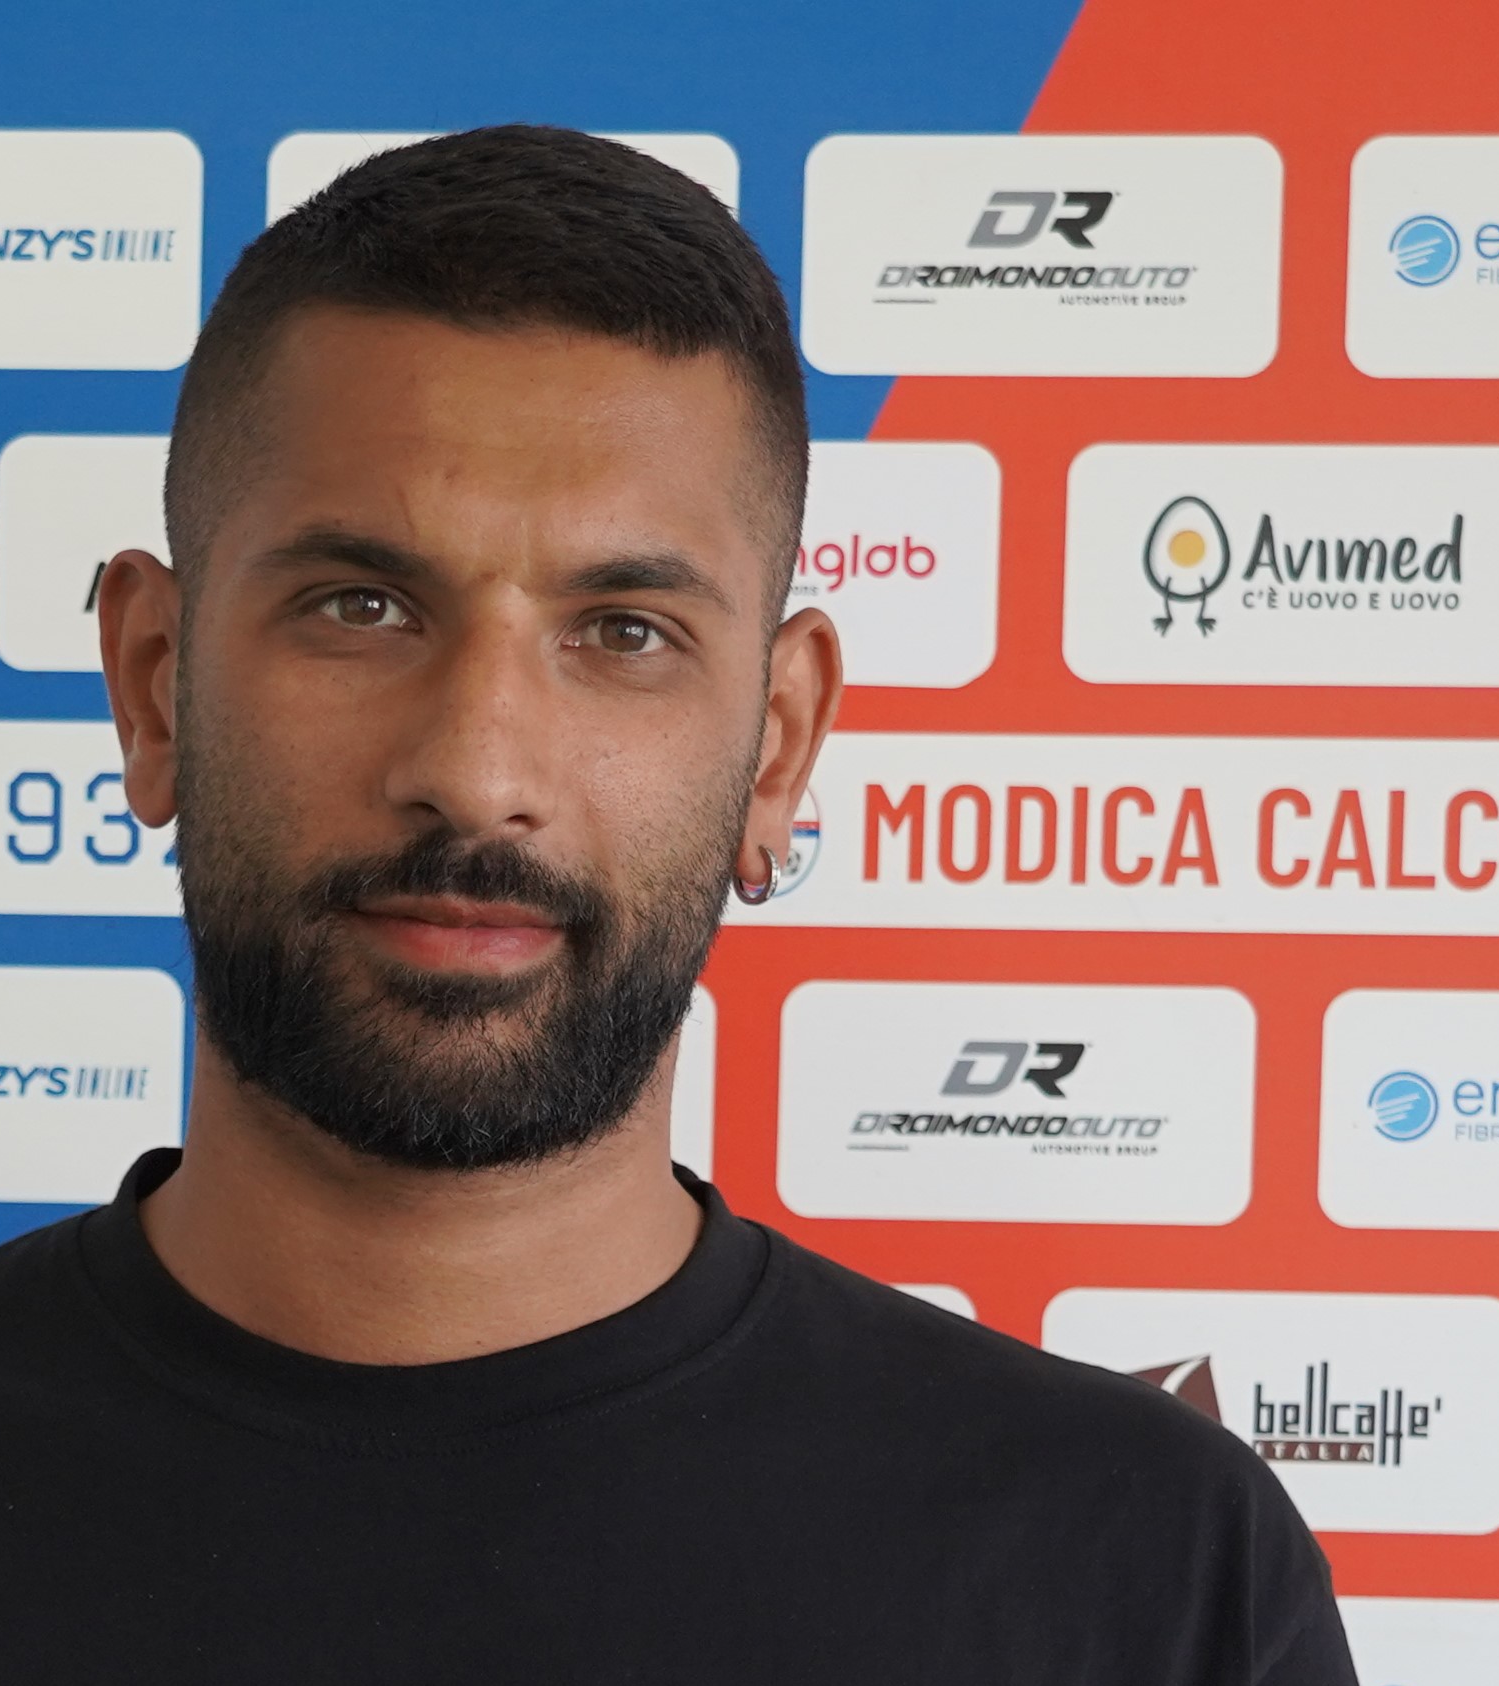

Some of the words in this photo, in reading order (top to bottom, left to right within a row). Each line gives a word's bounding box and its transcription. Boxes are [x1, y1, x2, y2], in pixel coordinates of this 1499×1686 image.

[1241, 513, 1464, 585] Avimed
[1288, 590, 1359, 611] UOVO
[1368, 591, 1381, 611] E
[1390, 591, 1461, 612] UOVO
[862, 783, 1220, 887] MODICA
